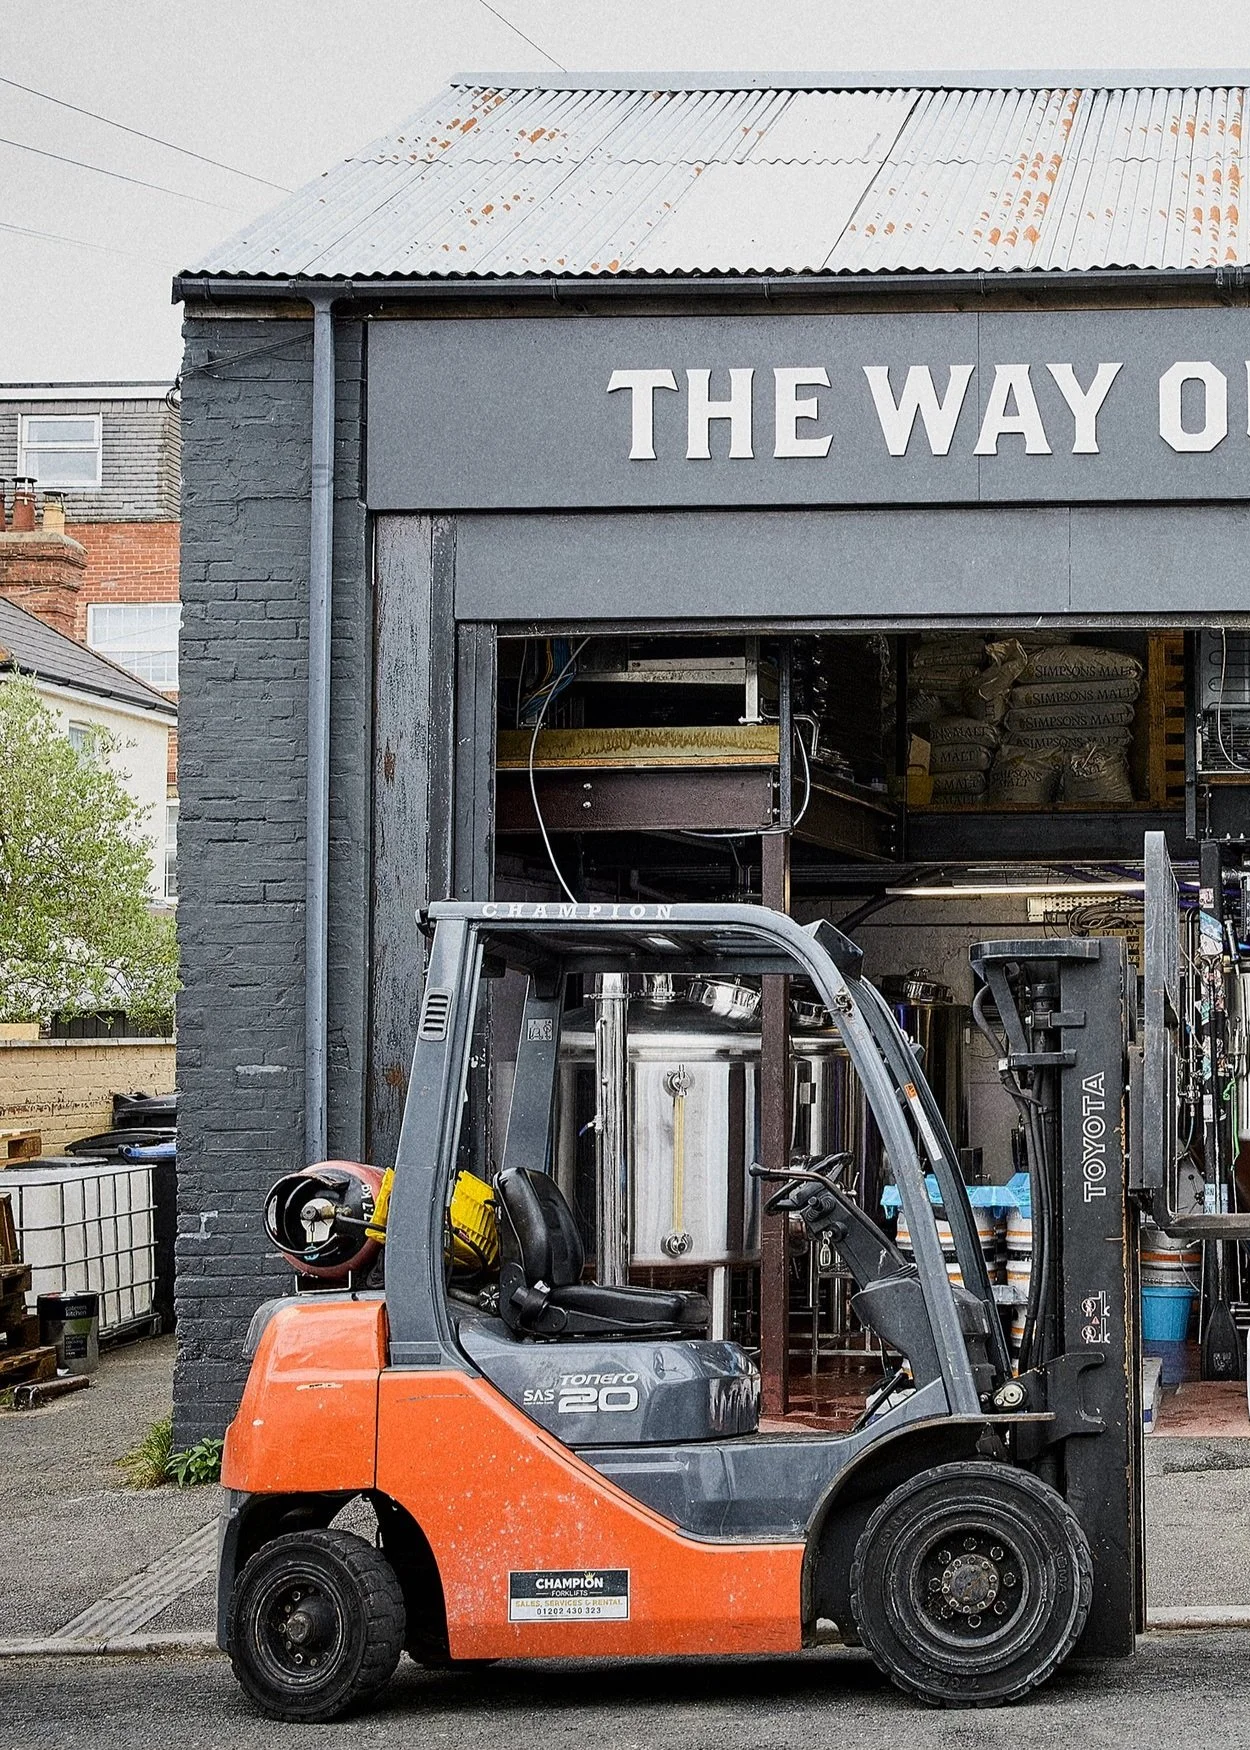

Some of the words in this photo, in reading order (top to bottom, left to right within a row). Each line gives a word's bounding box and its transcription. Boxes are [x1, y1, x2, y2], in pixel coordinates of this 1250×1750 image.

[607, 367, 833, 461] THE
[863, 361, 1124, 457] WAY
[1034, 664, 1096, 679] SIMPSONS
[1032, 690, 1094, 705] SIMPSONS
[1097, 687, 1134, 701] MALT
[1025, 715, 1088, 729] SIMPSONS
[1091, 712, 1127, 726] MALT
[481, 903, 677, 919] CHAMPION
[1081, 1070, 1106, 1203] TOYOTA
[361, 1184, 373, 1199] kg
[523, 1388, 555, 1402] SAS
[558, 1386, 639, 1414] 20
[535, 1577, 604, 1590] CHAMPION
[551, 1589, 588, 1598] FORKLIFTS
[515, 1600, 543, 1608] SALES,
[545, 1599, 582, 1607] SERVICES
[593, 1598, 622, 1607] RENTAL
[536, 1607, 564, 1616] 01202
[567, 1607, 583, 1615] 430
[585, 1606, 601, 1614] 323
